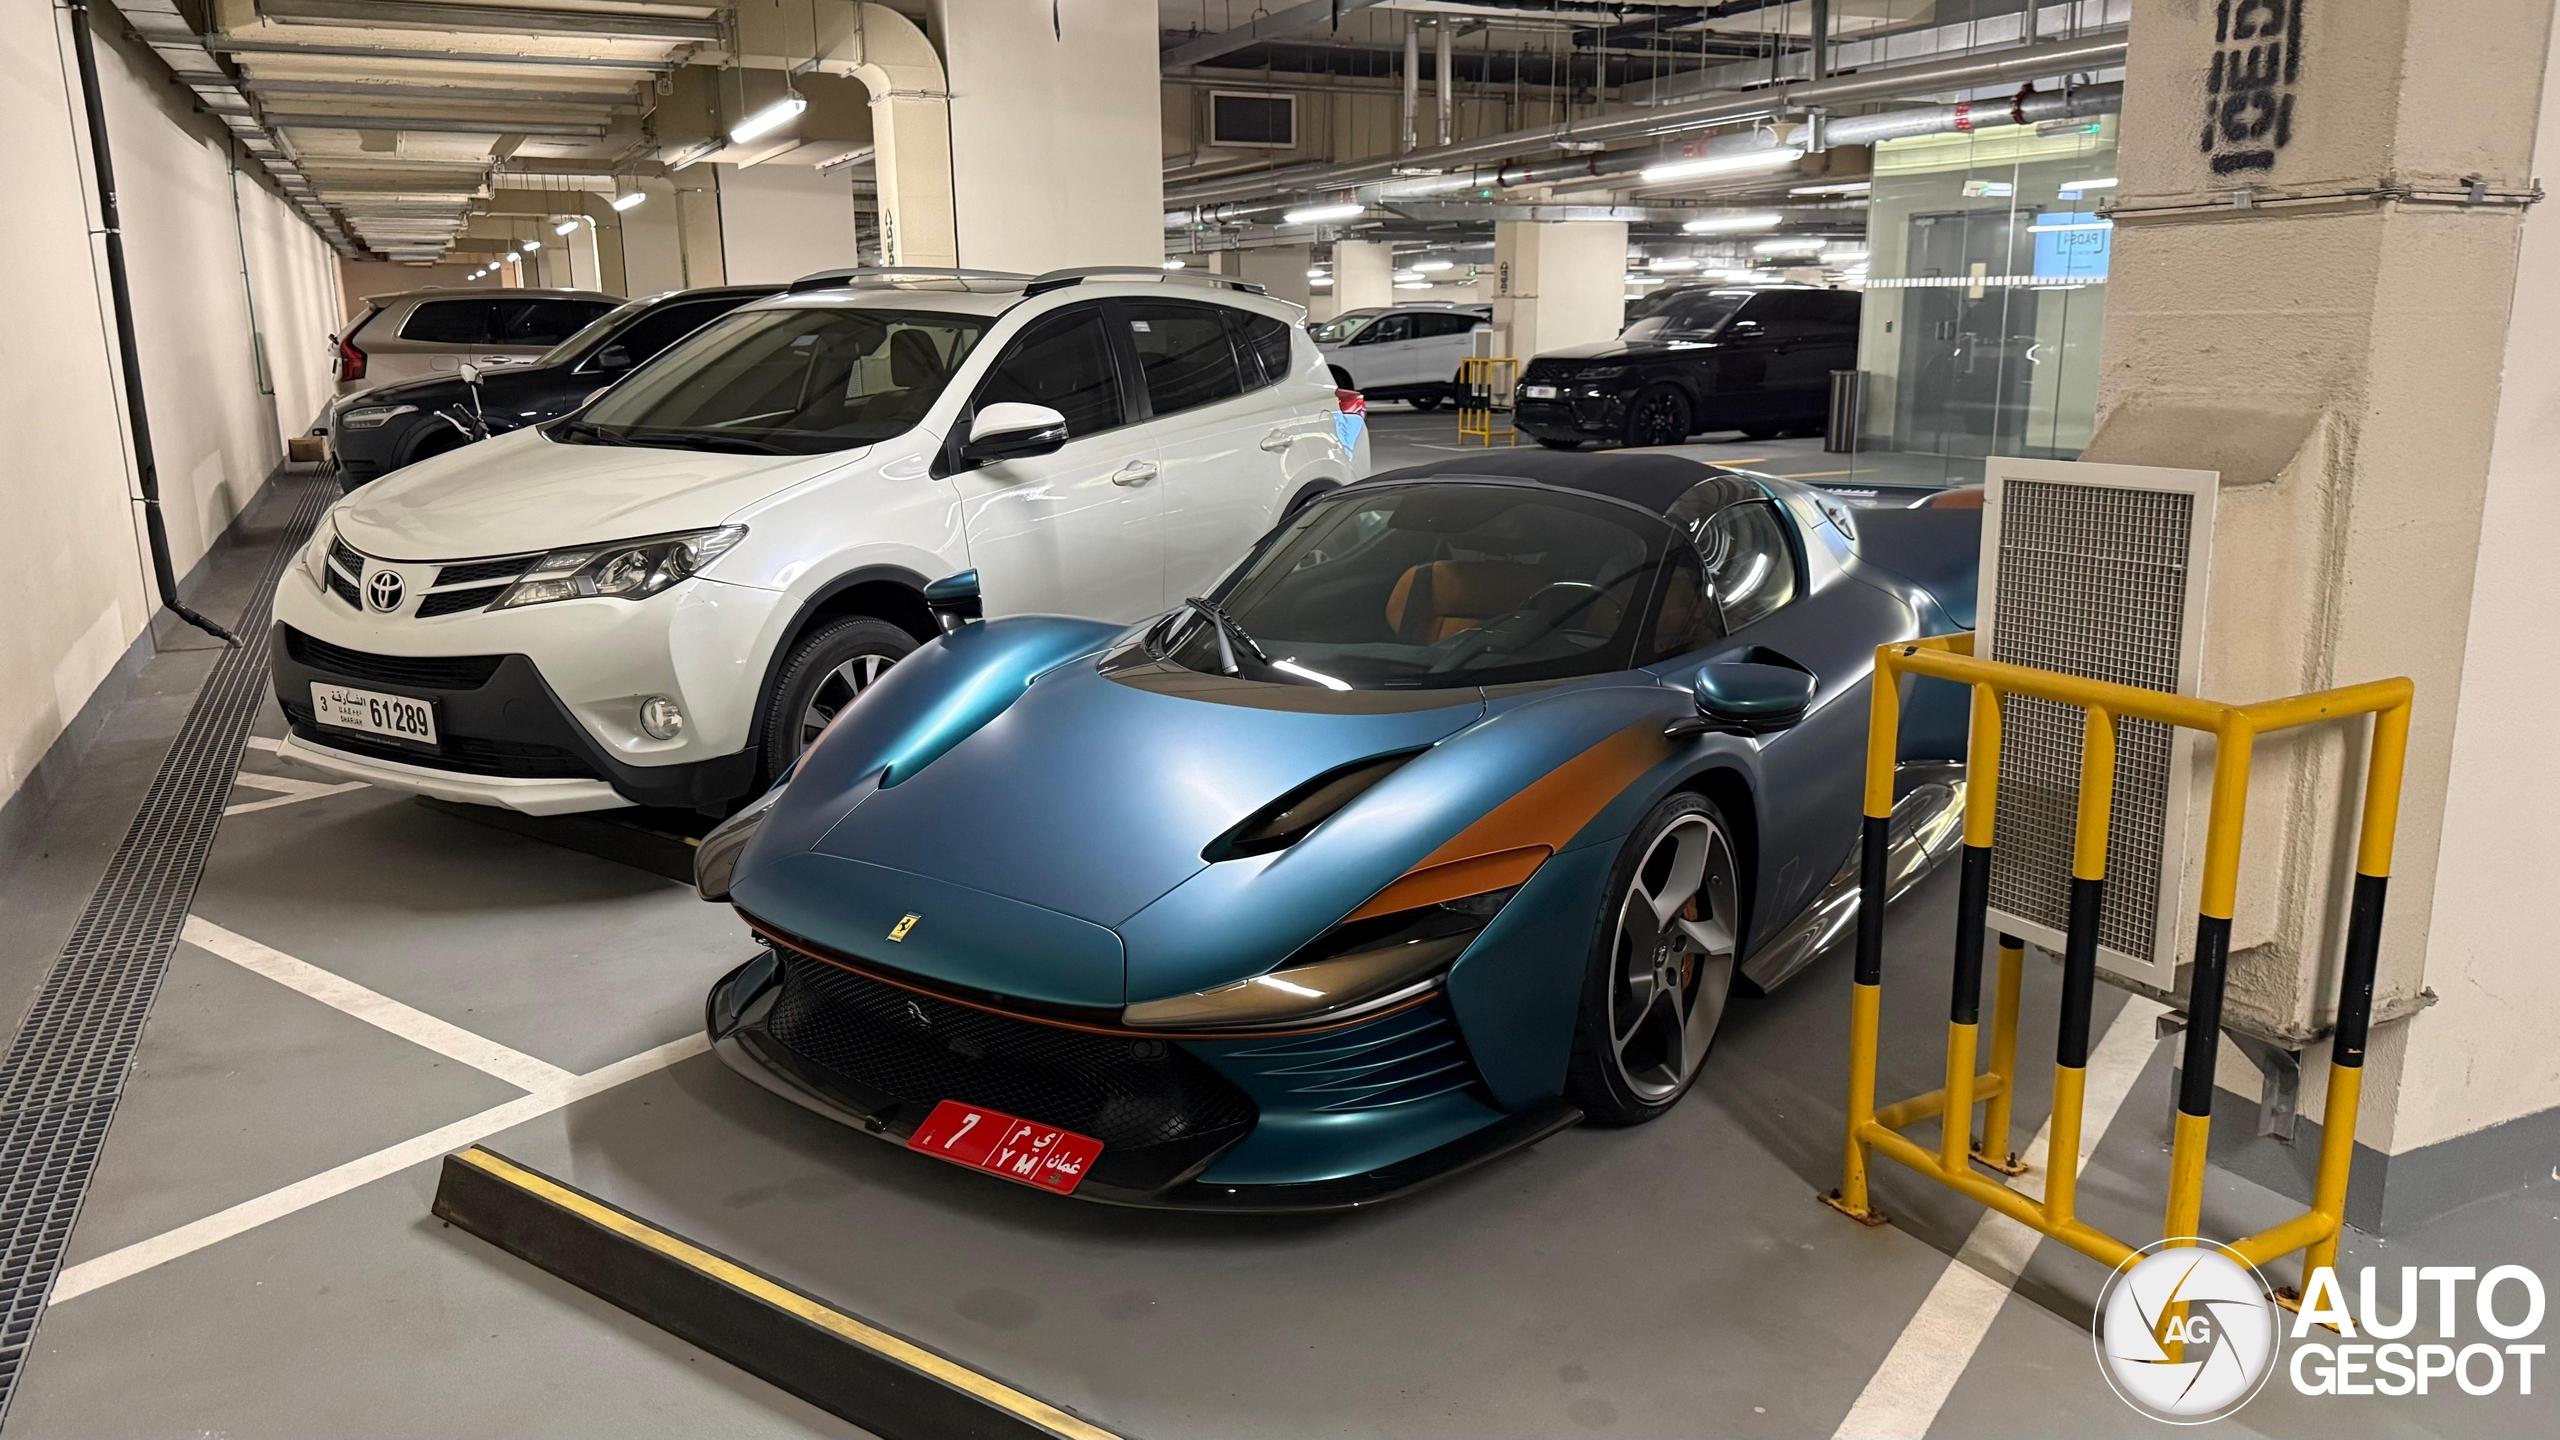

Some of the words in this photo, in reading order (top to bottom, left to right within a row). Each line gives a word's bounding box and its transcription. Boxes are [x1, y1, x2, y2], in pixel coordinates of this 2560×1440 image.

[320, 696, 328, 711] 3
[369, 698, 428, 736] 61289
[944, 1113, 981, 1149] 7
